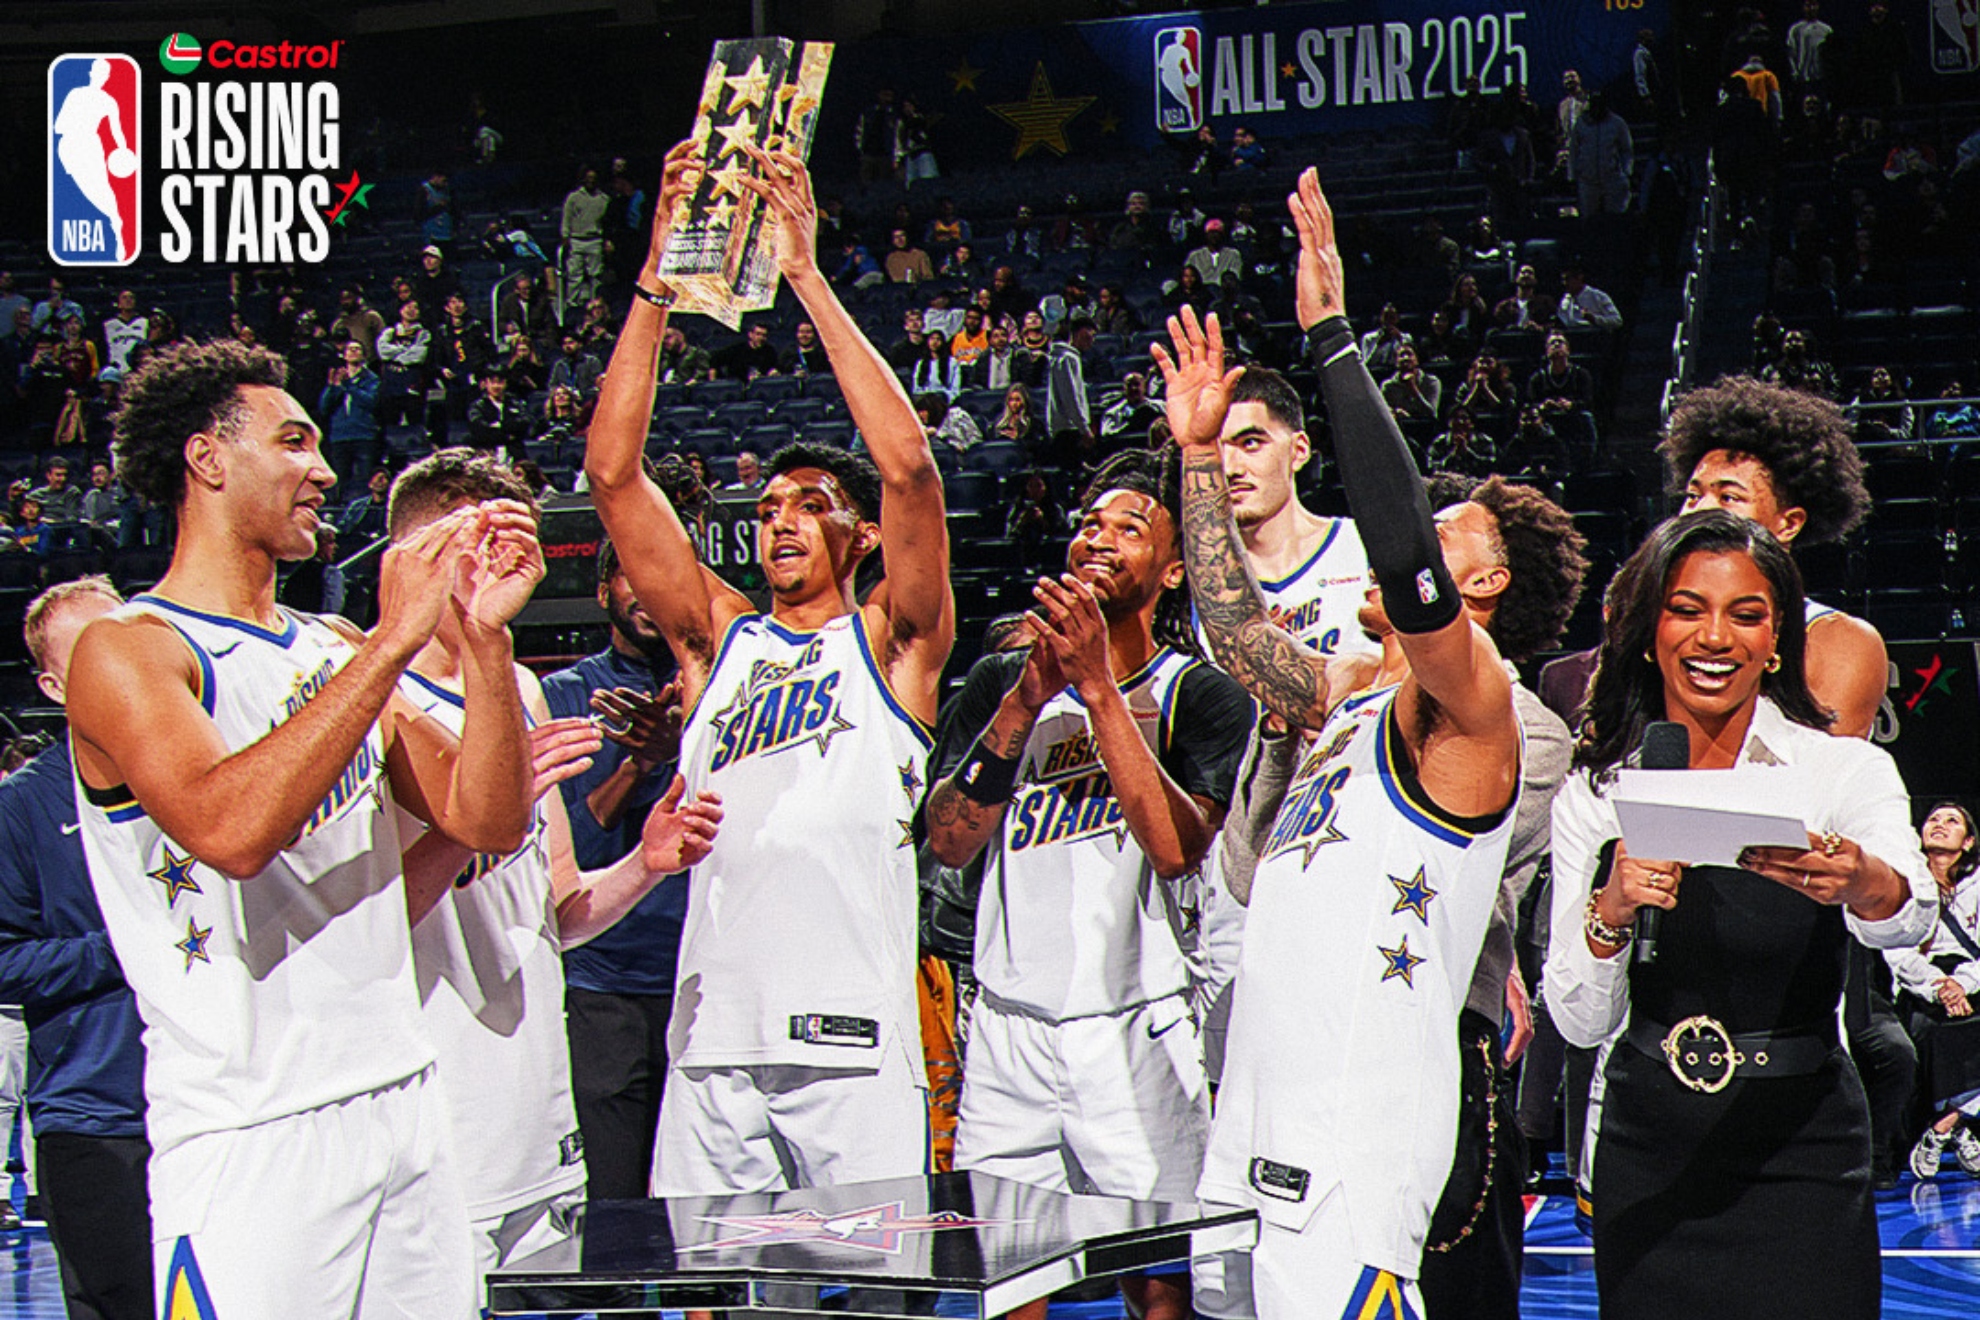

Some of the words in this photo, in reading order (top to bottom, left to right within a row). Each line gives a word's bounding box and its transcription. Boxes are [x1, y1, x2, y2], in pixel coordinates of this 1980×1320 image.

[1211, 33, 1286, 116] ALL
[1297, 23, 1413, 109] STAR
[1423, 12, 1528, 99] 2025
[1163, 108, 1186, 125] NBA
[709, 670, 841, 774] STARS
